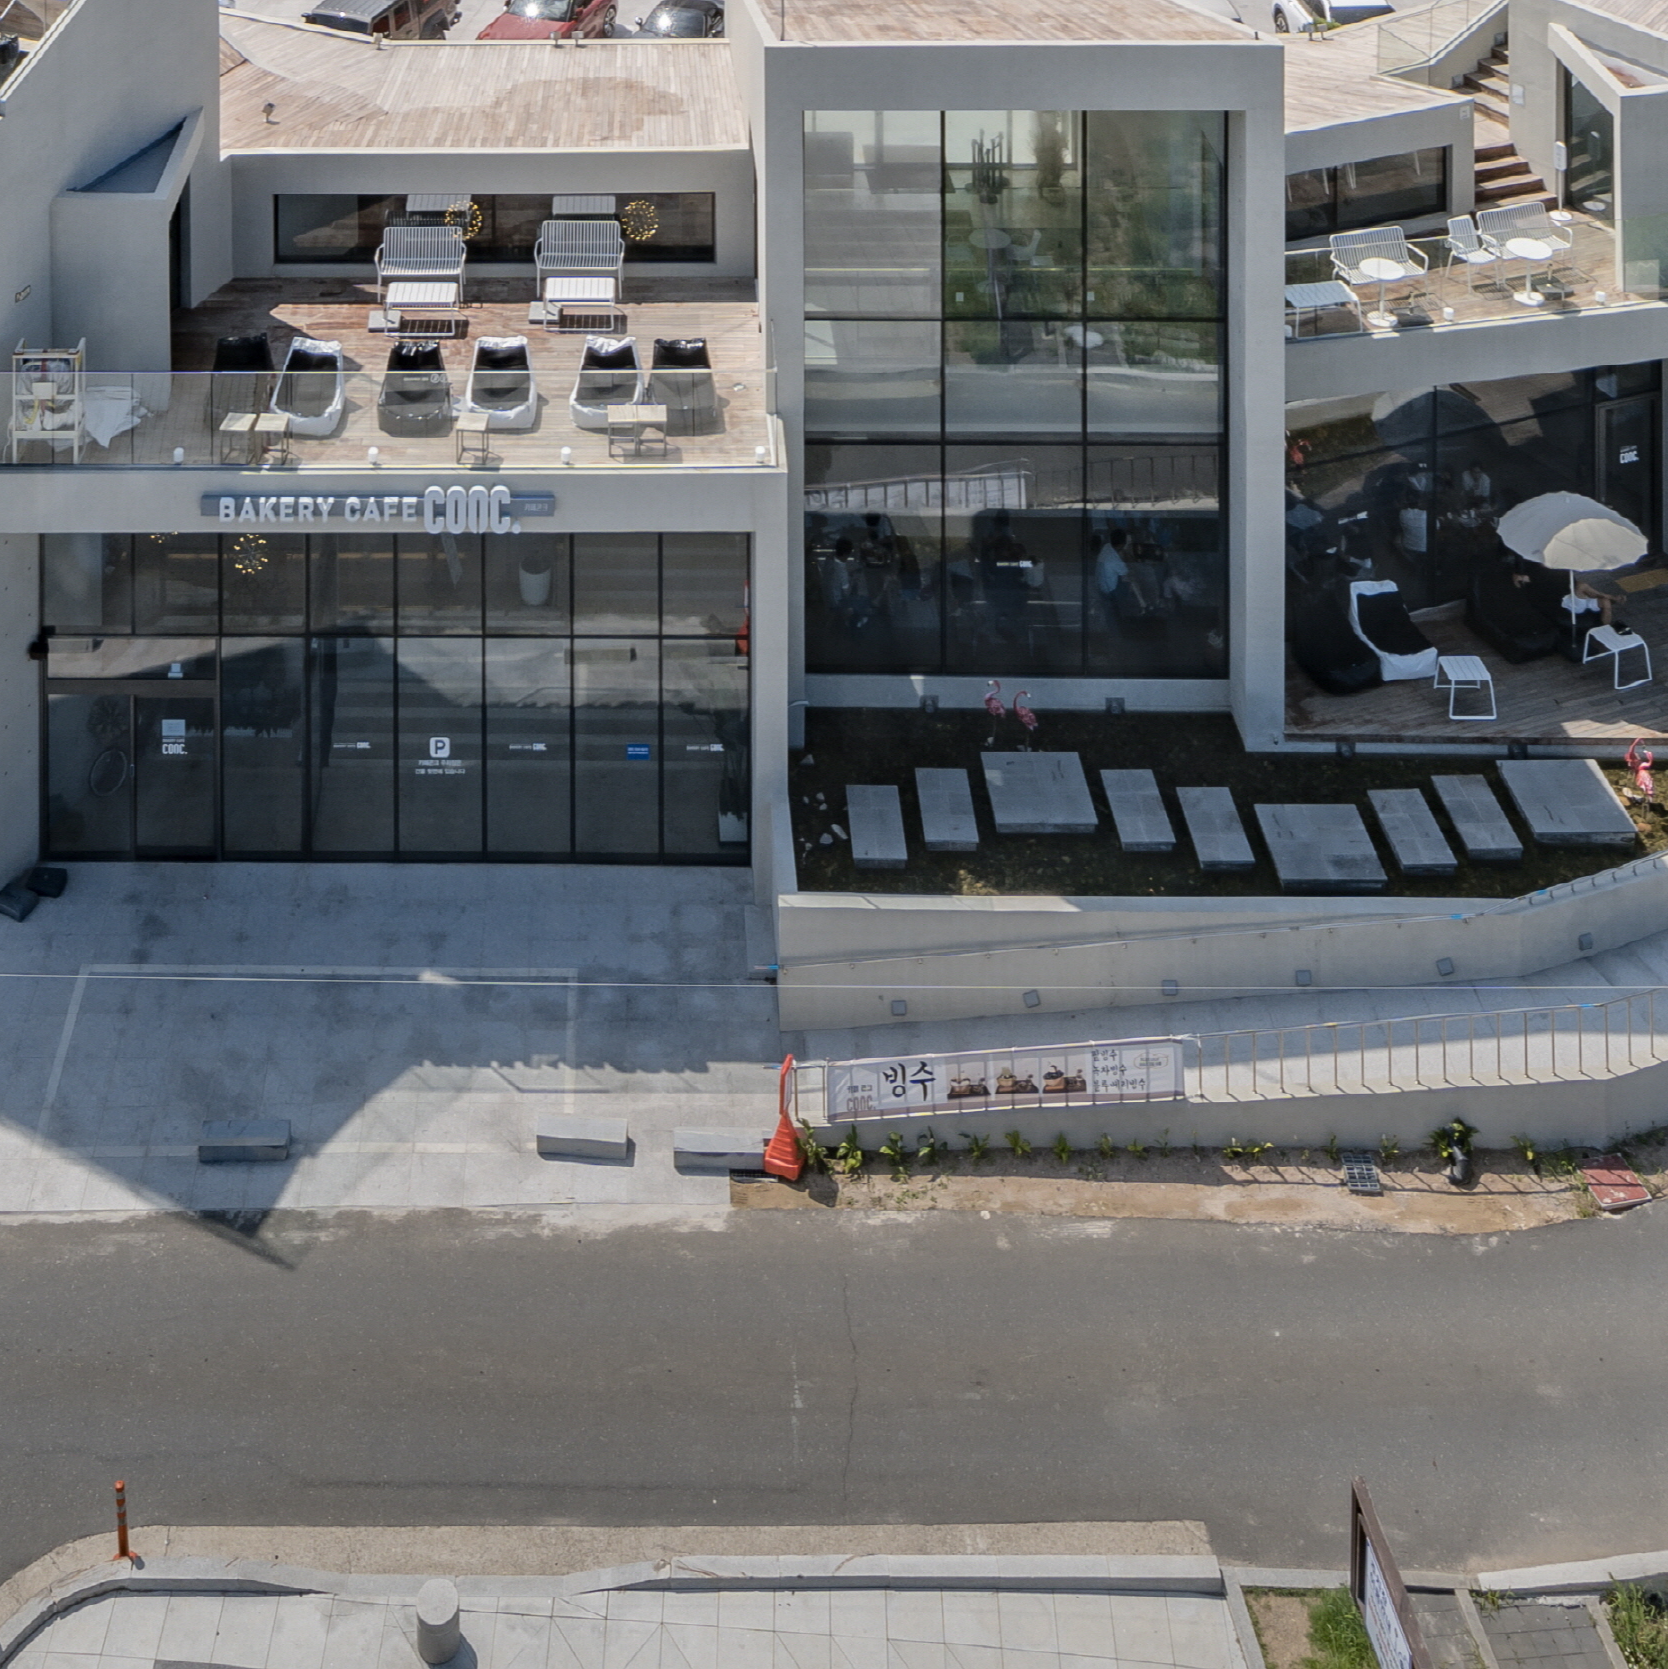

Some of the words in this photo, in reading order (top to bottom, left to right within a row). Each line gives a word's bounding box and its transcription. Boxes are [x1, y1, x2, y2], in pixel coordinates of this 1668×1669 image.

[218, 496, 335, 524] BAKERY
[343, 496, 419, 524] CAFE
[881, 1061, 937, 1102] 빙수
